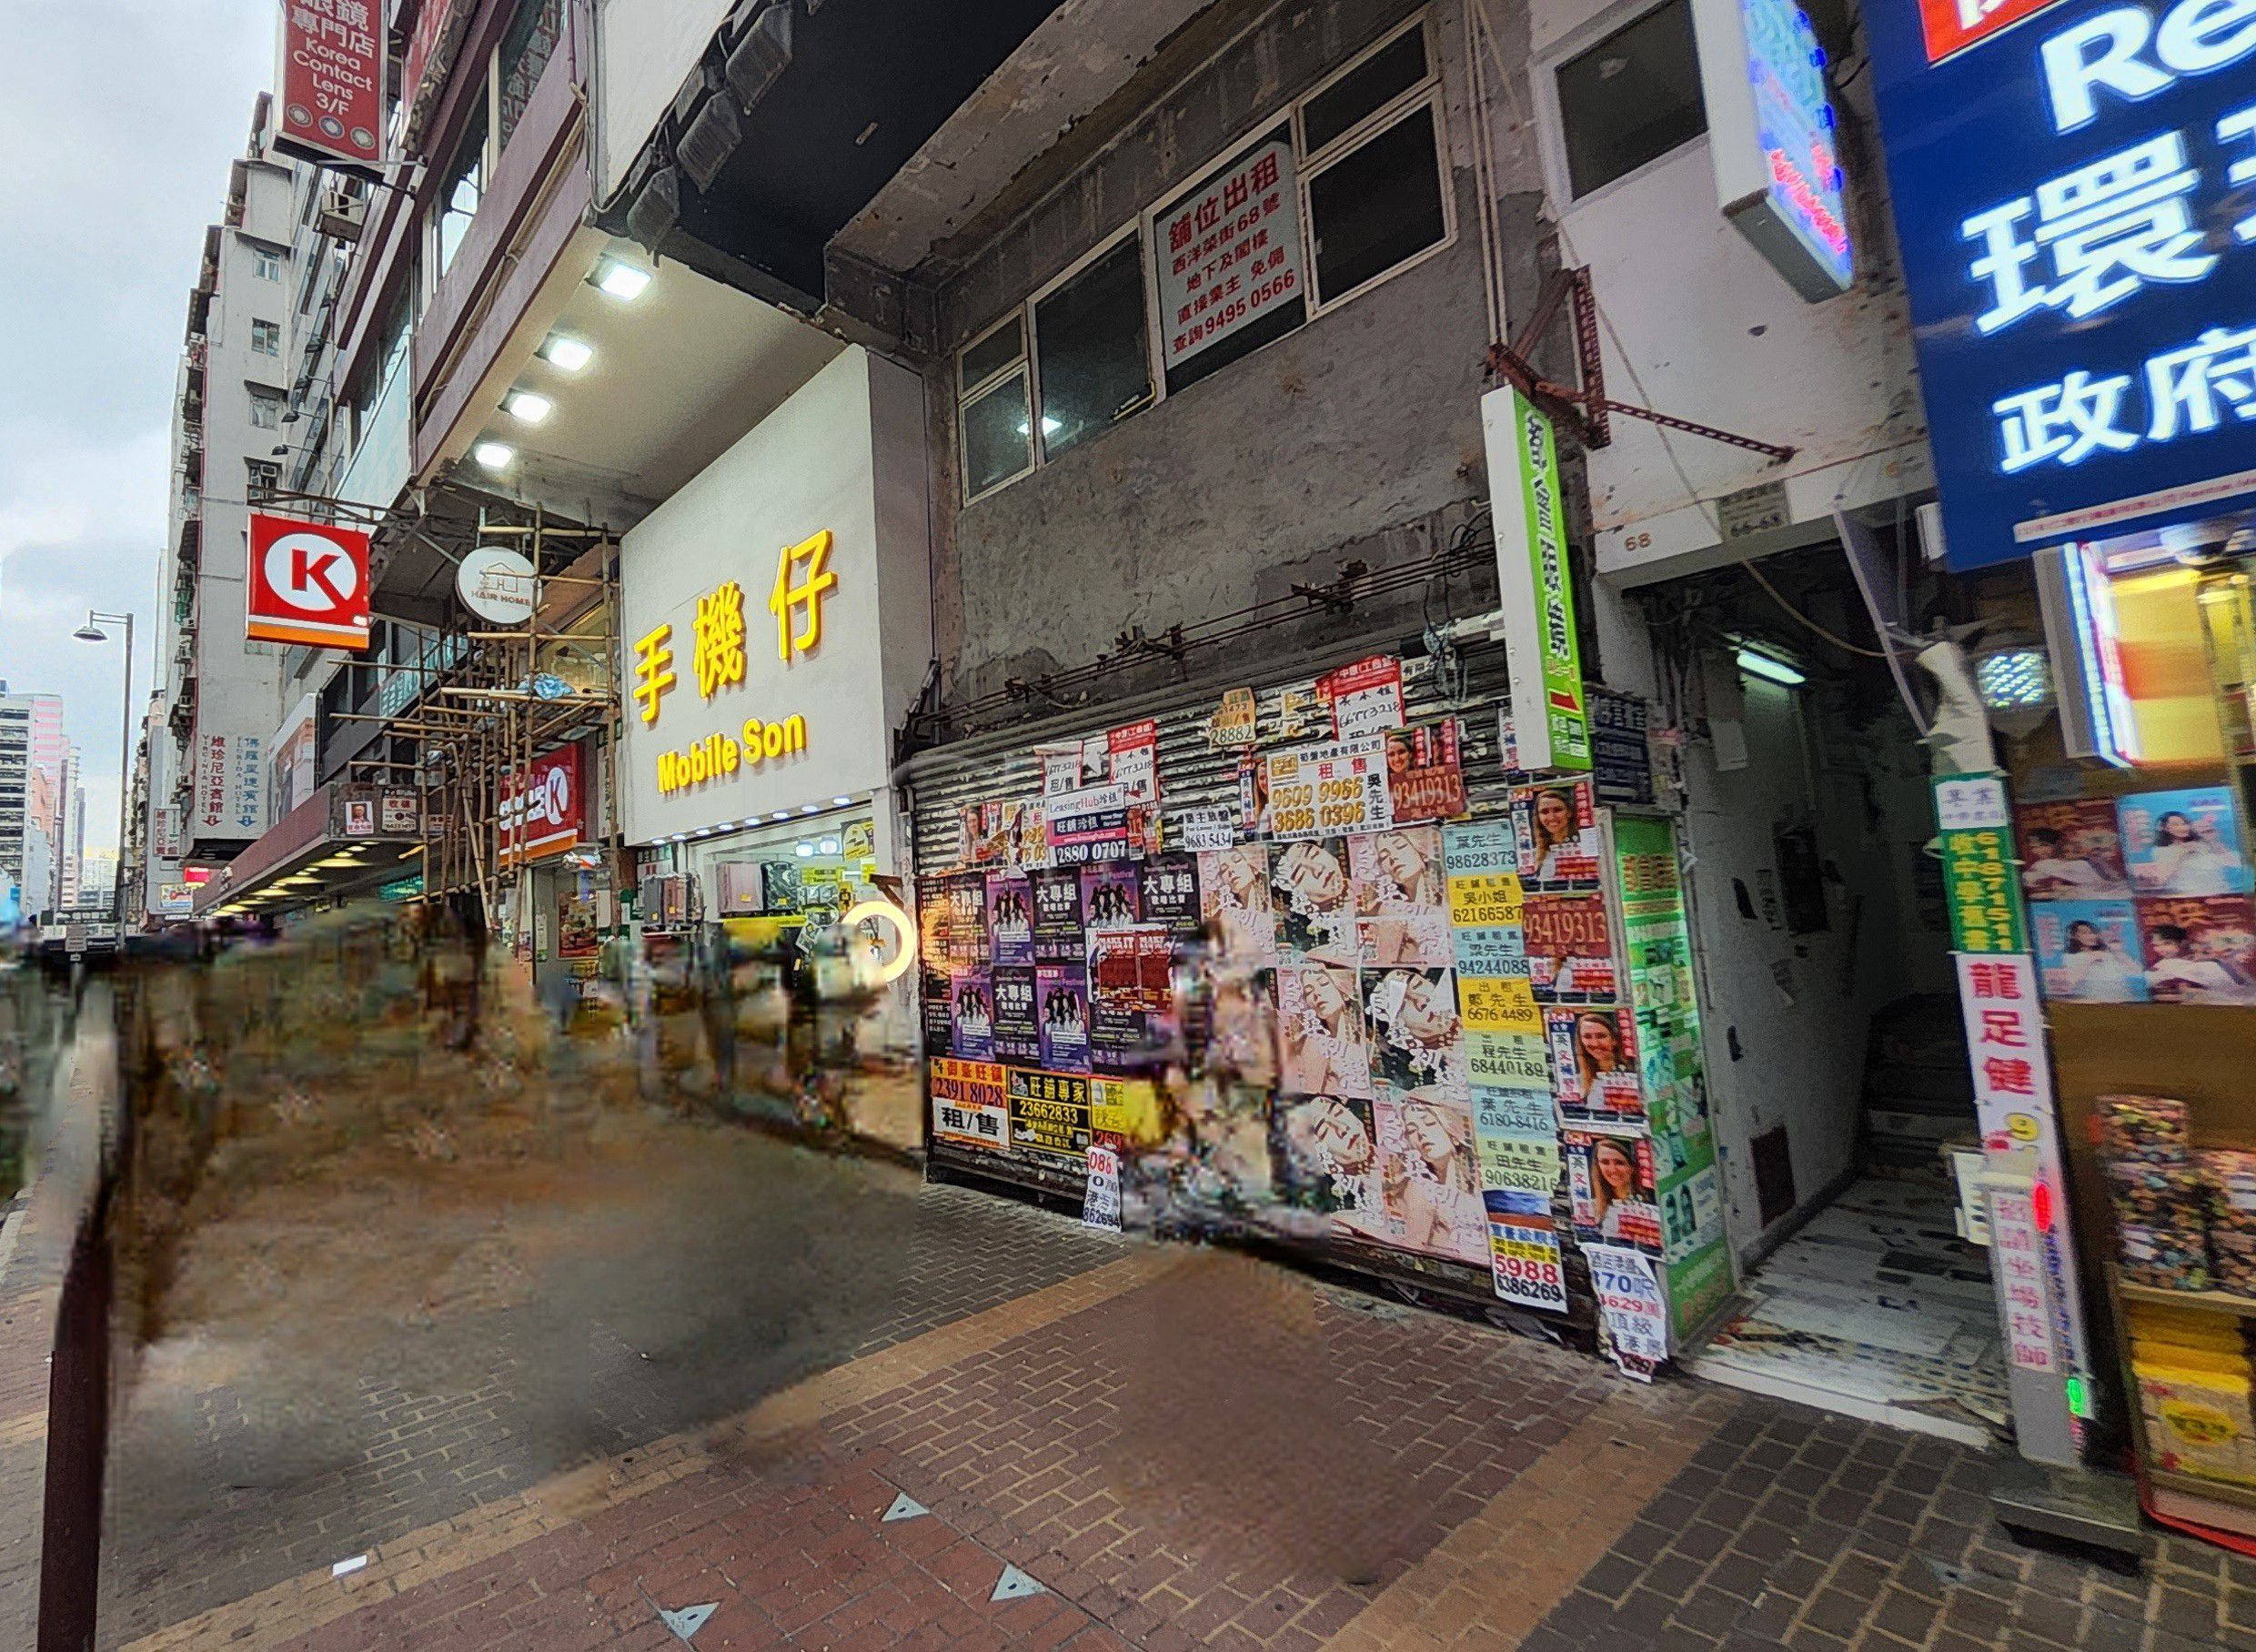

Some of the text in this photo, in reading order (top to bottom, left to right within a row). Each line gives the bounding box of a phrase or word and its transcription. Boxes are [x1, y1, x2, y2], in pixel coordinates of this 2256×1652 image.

[292, 5, 376, 58] 專門店
[306, 36, 360, 71] Korea
[293, 50, 372, 92] Contact
[312, 73, 353, 100] Lens
[316, 93, 349, 116] 3/F
[1962, 106, 2256, 334] 環
[1250, 268, 1295, 308] 0566
[1625, 532, 1652, 552] 68
[471, 590, 531, 607] HAIR HOME
[633, 529, 838, 722] 手機仔
[657, 713, 808, 794] Mobile Son
[1057, 843, 1089, 863] 2880
[1092, 840, 1127, 860] 0707
[1446, 850, 1518, 870] 98628373
[1142, 872, 1194, 895] 大專組
[970, 1082, 1004, 1109] 8028
[941, 1106, 1001, 1136] 租/售
[1019, 1100, 1079, 1124] 23662833
[1495, 1254, 1559, 1284] 5988
